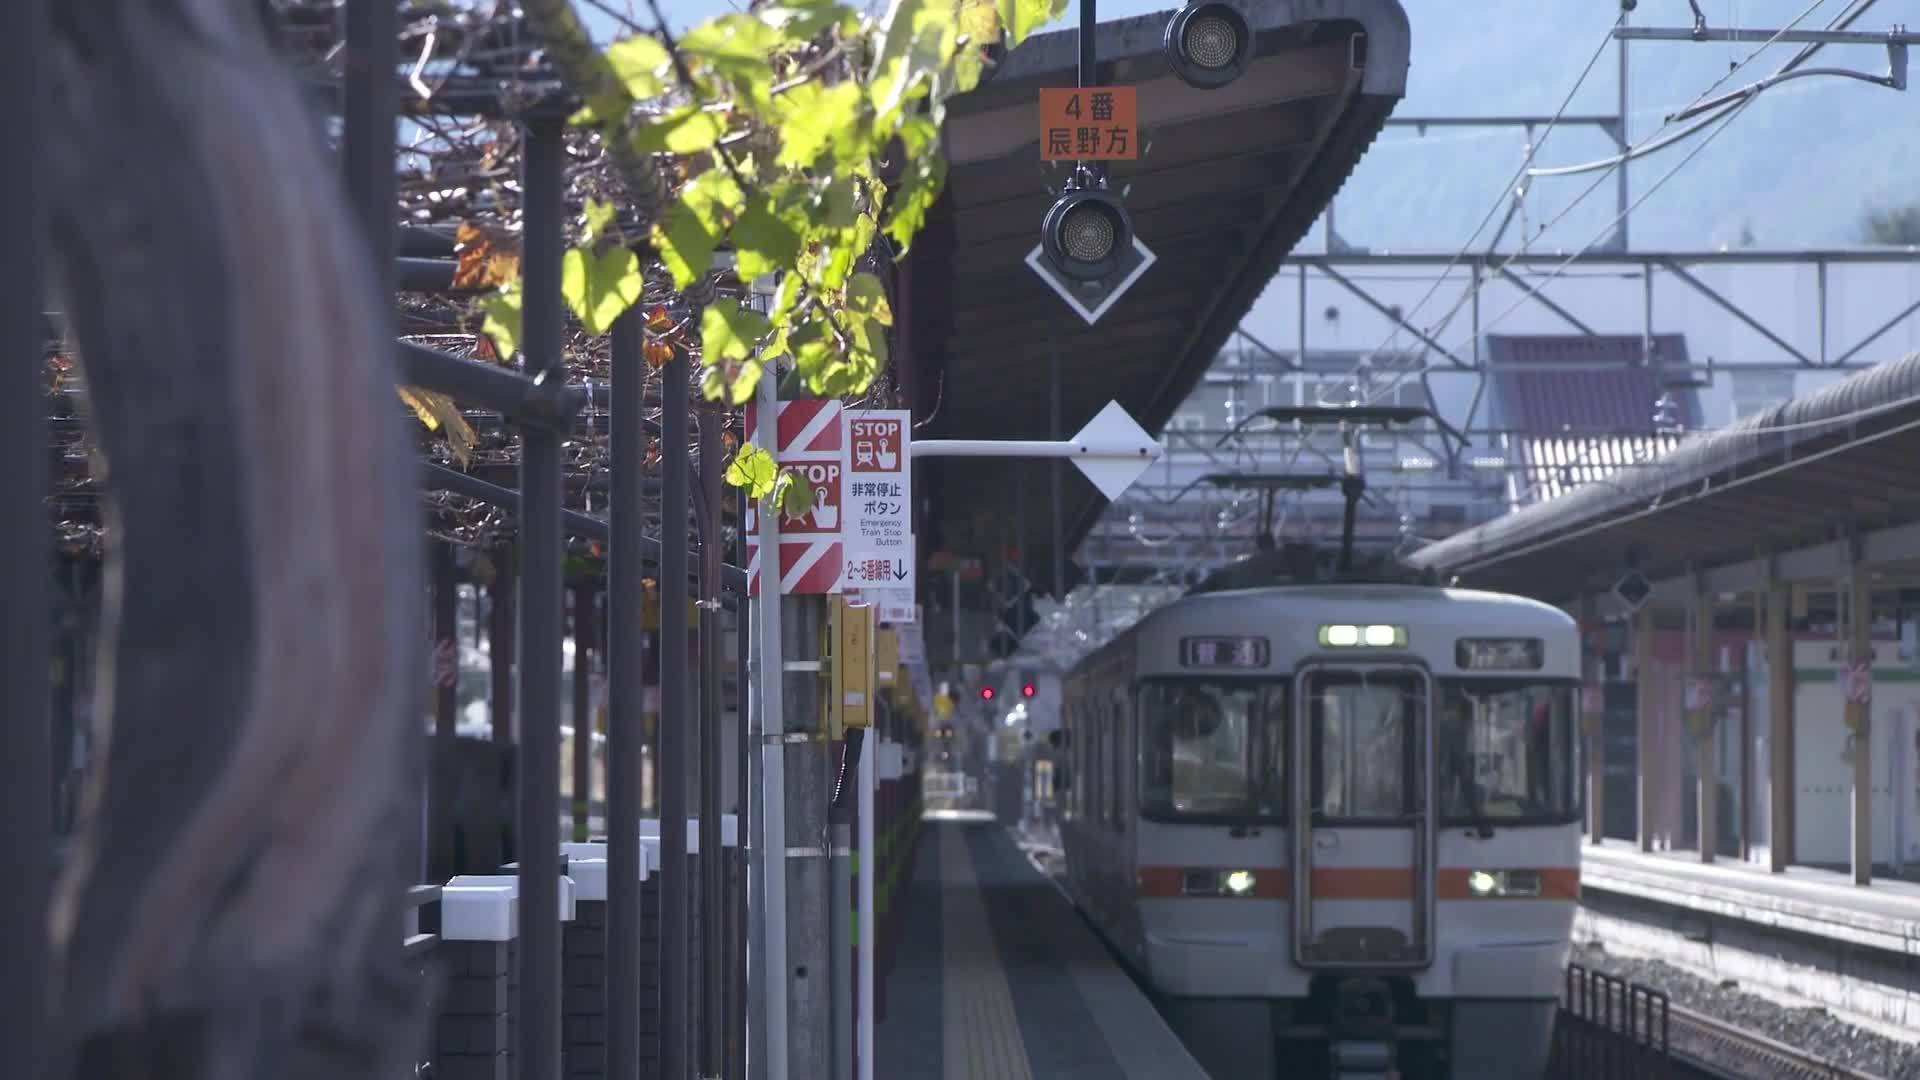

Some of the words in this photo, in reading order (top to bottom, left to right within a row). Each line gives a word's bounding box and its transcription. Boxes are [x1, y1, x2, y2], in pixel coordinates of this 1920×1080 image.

[1047, 126, 1129, 155] 辰野方
[855, 422, 898, 436] STOP
[852, 483, 901, 497] 非常停止
[864, 502, 901, 515] ボタン
[860, 519, 901, 527] Emergency
[861, 528, 881, 536] Train
[884, 528, 902, 537] Stop
[875, 538, 902, 546] Button
